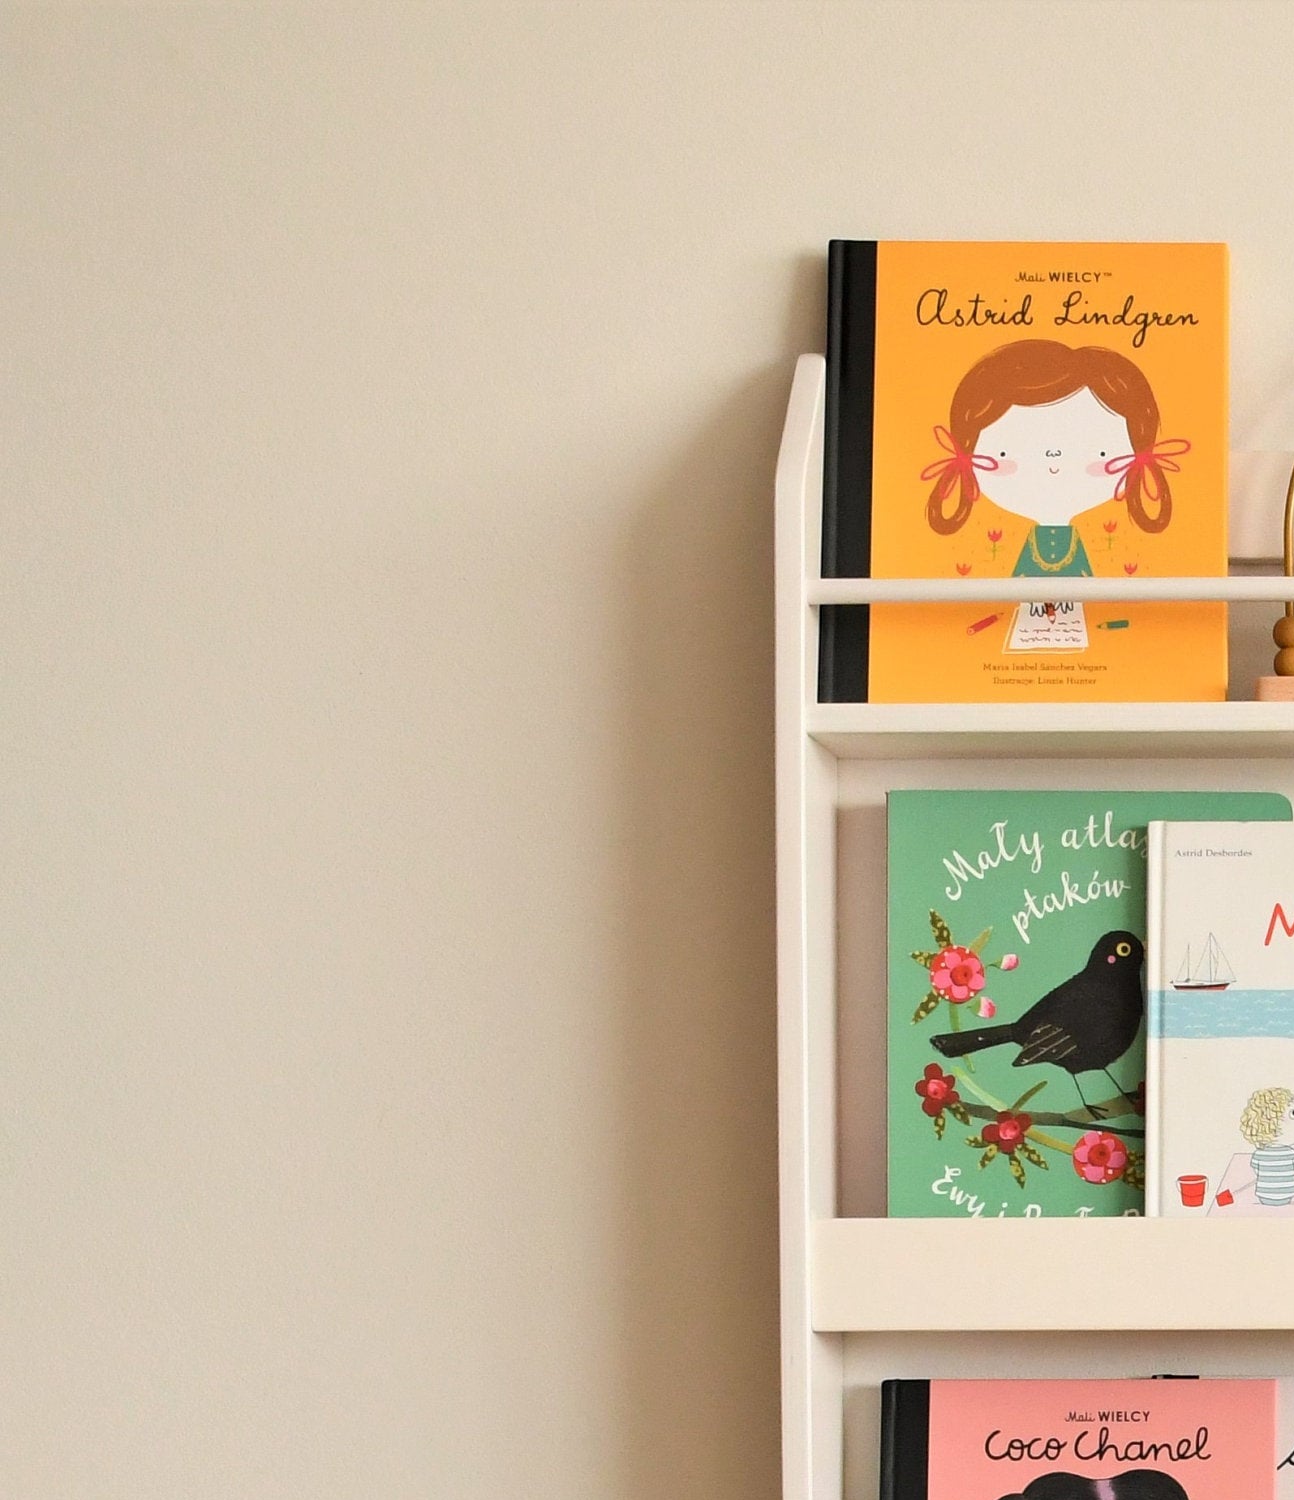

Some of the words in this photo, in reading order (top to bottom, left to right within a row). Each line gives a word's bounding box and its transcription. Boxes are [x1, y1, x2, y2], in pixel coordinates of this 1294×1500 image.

[1015, 271, 1045, 282] Mali
[916, 288, 1033, 327] Astrid
[1053, 290, 1199, 348] Lindgren
[943, 819, 1044, 901] Mały
[1175, 848, 1203, 857] Astrid
[1206, 848, 1253, 857] Desbordes
[1012, 870, 1131, 944] ptaków
[1065, 1411, 1095, 1422] Mali
[1098, 1411, 1150, 1422] WIELCY
[985, 1430, 1067, 1461] Coco
[1074, 1426, 1212, 1461] Chanel
